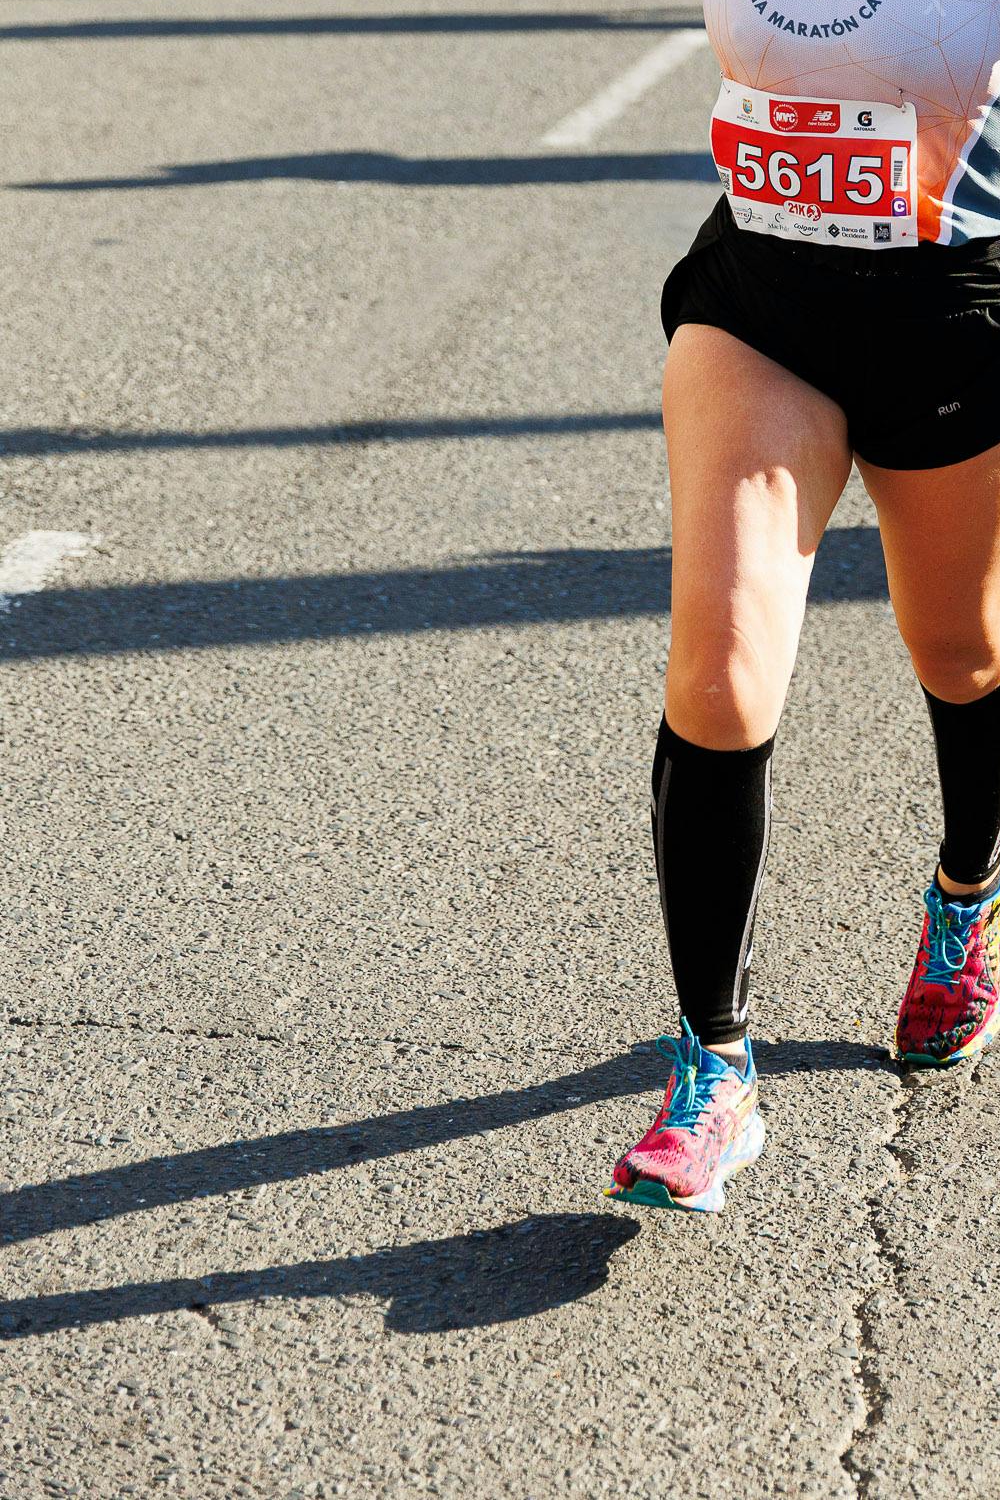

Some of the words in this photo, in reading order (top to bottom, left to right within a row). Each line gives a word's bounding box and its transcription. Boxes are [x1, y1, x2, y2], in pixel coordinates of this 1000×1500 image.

[767, 11, 860, 39] MARATÓN
[857, 110, 873, 127] G
[735, 141, 884, 205] 5615
[788, 202, 806, 217] 21K
[893, 200, 906, 213] C
[793, 222, 819, 232] Colgate
